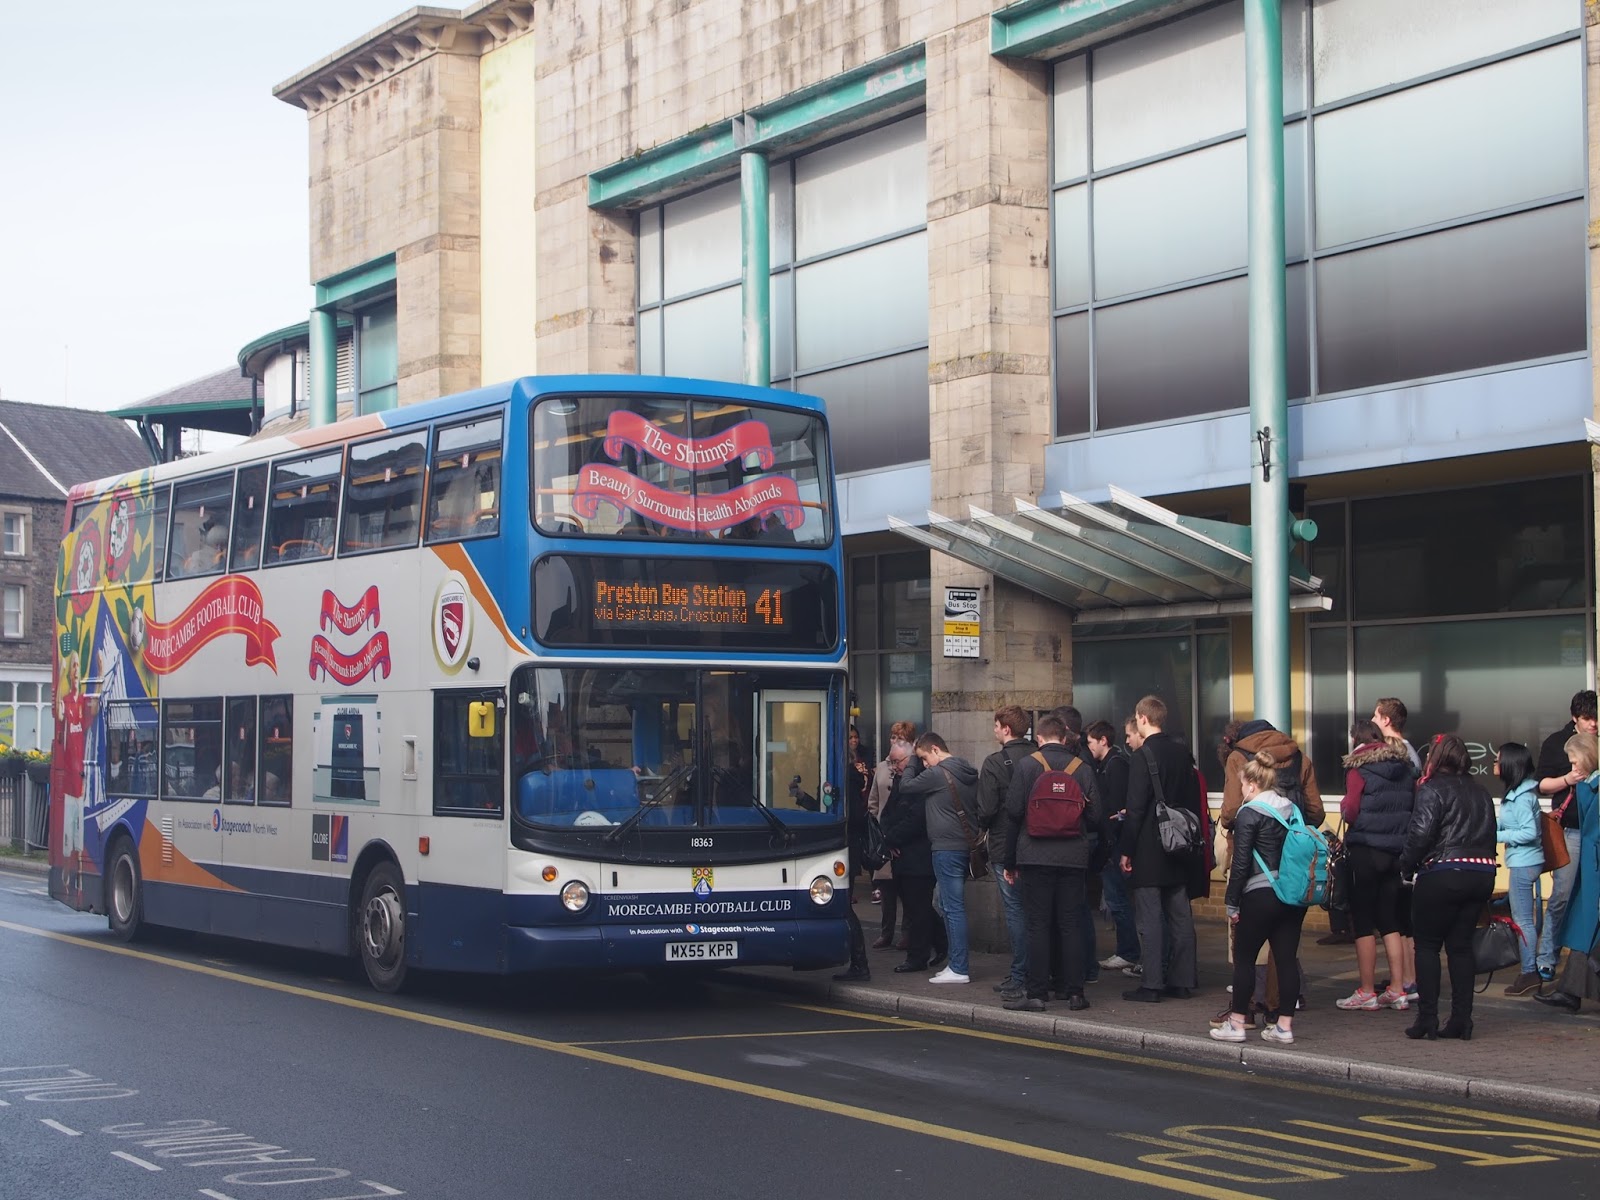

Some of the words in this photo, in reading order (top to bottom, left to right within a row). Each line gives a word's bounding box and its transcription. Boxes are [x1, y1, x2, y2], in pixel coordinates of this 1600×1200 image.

[642, 424, 671, 456] The
[675, 437, 736, 464] Shrimps
[589, 470, 635, 499] Beauty
[634, 490, 696, 522] Surrounds
[697, 503, 733, 523] Health
[735, 484, 782, 515] Abounds
[597, 581, 658, 604] Preston
[662, 584, 689, 605] Bus
[693, 585, 746, 607] Station
[333, 599, 343, 624] The
[343, 604, 366, 629] Shrimps
[594, 605, 613, 621] via
[680, 607, 730, 623] Croston
[732, 609, 747, 624] Rd
[755, 589, 784, 625] 41
[149, 617, 196, 658] MORECAMBE
[197, 595, 237, 631] FOOTBALL
[238, 595, 261, 625] CLUB
[350, 660, 364, 677] Health
[363, 639, 383, 669] Abounds
[177, 818, 182, 828] In
[182, 818, 202, 830] Association
[203, 821, 212, 830] with
[221, 818, 251, 835] Stagecoach
[252, 824, 266, 834] North
[266, 825, 278, 835] West
[313, 832, 329, 844] GLOBE
[691, 837, 713, 848] 18363
[608, 904, 692, 917] MORECAMBE
[694, 901, 758, 914] FOOTBALL
[759, 899, 791, 911] CLUB
[700, 925, 742, 935] Stagecoach
[743, 925, 760, 933] North
[760, 925, 775, 933] West
[671, 944, 704, 958] MX55
[708, 943, 734, 957] KPR
